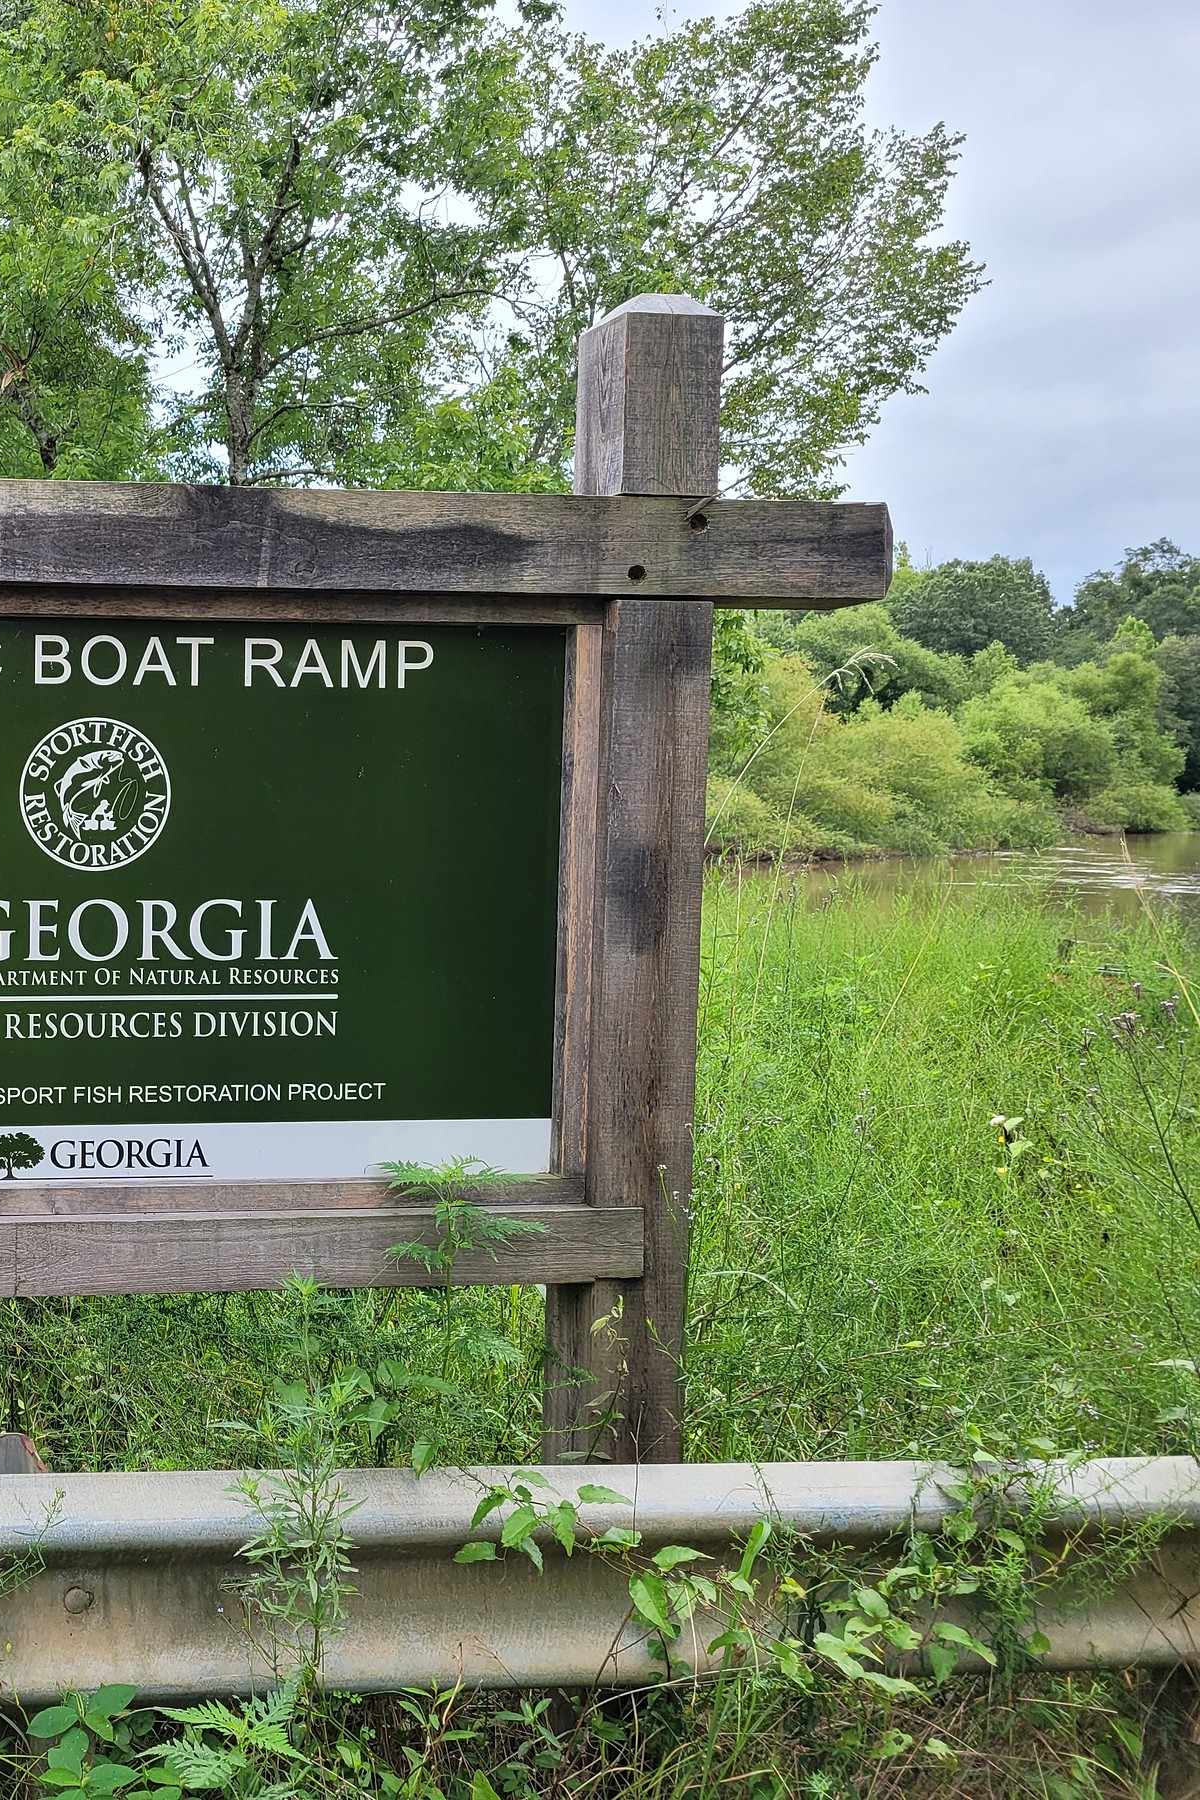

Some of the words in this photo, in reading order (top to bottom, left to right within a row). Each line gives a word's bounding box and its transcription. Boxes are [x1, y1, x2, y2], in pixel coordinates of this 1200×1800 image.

[35, 635, 214, 686] BOAT
[244, 638, 435, 689] RAMP
[27, 720, 108, 783] SPORT
[106, 722, 165, 784] FISH
[23, 788, 168, 867] RESTORATION
[95, 968, 120, 985] OF
[130, 968, 221, 984] NATURAL
[229, 968, 338, 984] RESOURCES
[74, 1086, 121, 1103] FISH
[130, 1084, 280, 1102] RESTORATION
[289, 1083, 386, 1100] PROJECT
[51, 1139, 209, 1169] GEORGIA
